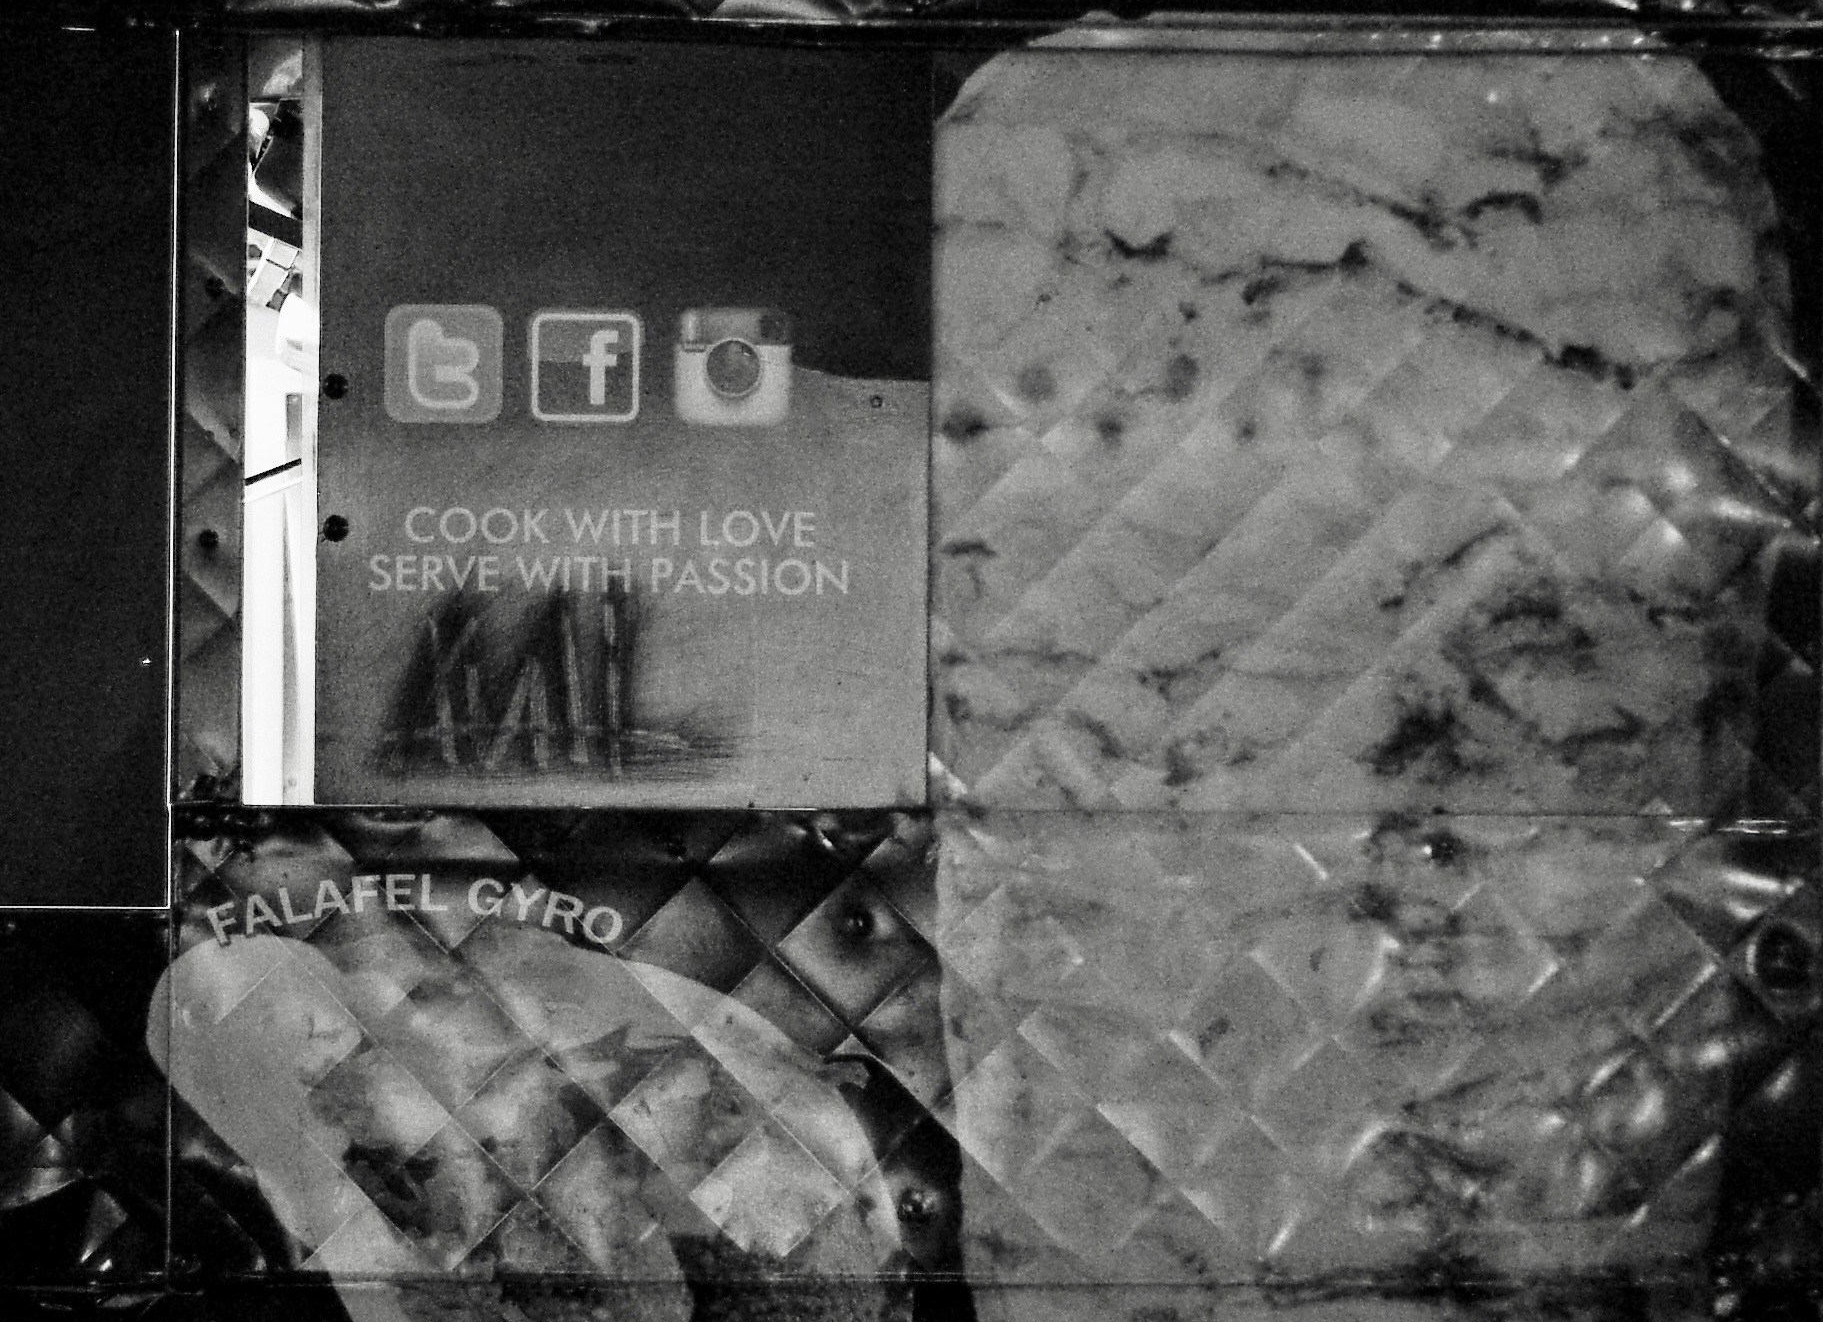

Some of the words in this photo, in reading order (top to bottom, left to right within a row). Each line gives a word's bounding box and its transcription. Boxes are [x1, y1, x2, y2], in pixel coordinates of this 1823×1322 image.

[404, 506, 551, 546] COOK
[566, 509, 681, 546] WITH
[699, 509, 816, 548] LOVE
[369, 553, 500, 592] SERVE
[517, 556, 633, 593] WITH
[651, 558, 849, 597] PASSION
[207, 873, 449, 947] FALAFEL
[467, 878, 623, 945] GYRO
